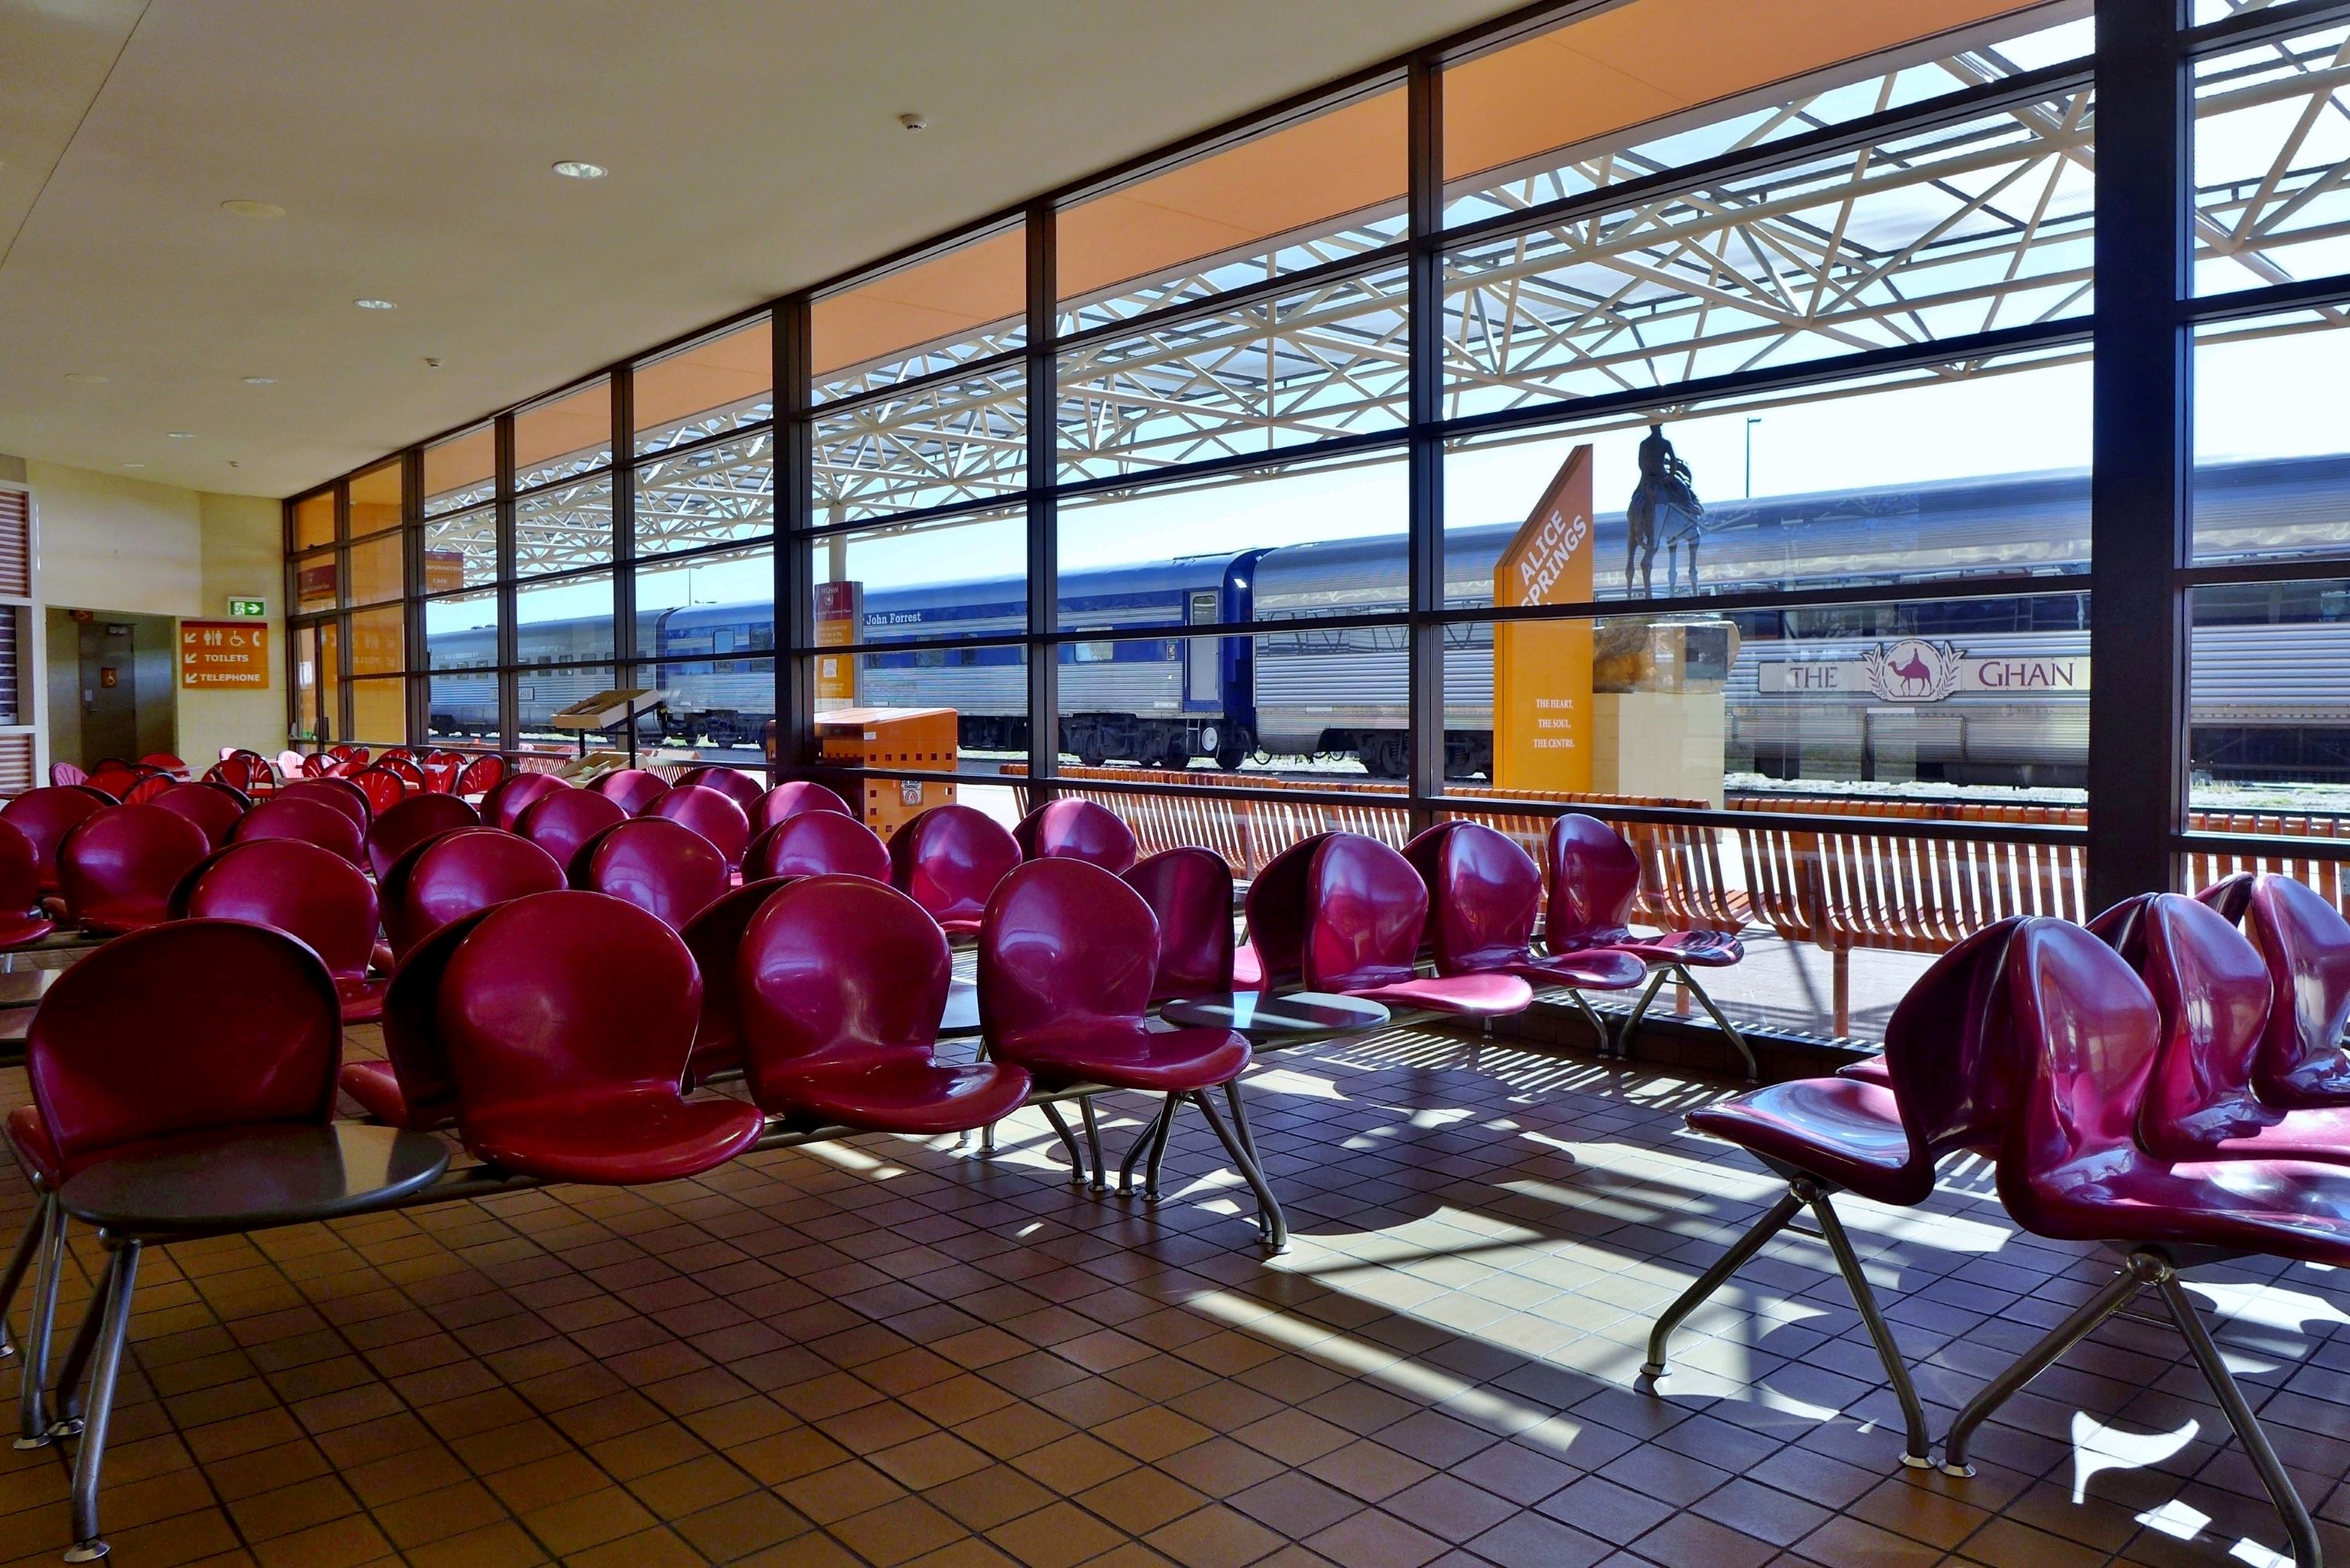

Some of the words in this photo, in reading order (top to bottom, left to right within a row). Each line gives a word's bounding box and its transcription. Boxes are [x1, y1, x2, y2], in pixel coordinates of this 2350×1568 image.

[1520, 510, 1566, 586] ALICE
[866, 614, 888, 625] John
[889, 611, 922, 623] Forrest
[1789, 667, 1838, 688] THE
[1979, 661, 2074, 688] GHAN
[1535, 699, 1550, 708] THE
[1550, 699, 1574, 709] HEART,
[1538, 719, 1552, 728] THE
[1553, 719, 1571, 728] SOUL,
[1533, 739, 1548, 748] THE
[1548, 739, 1575, 748] CENTRE.
